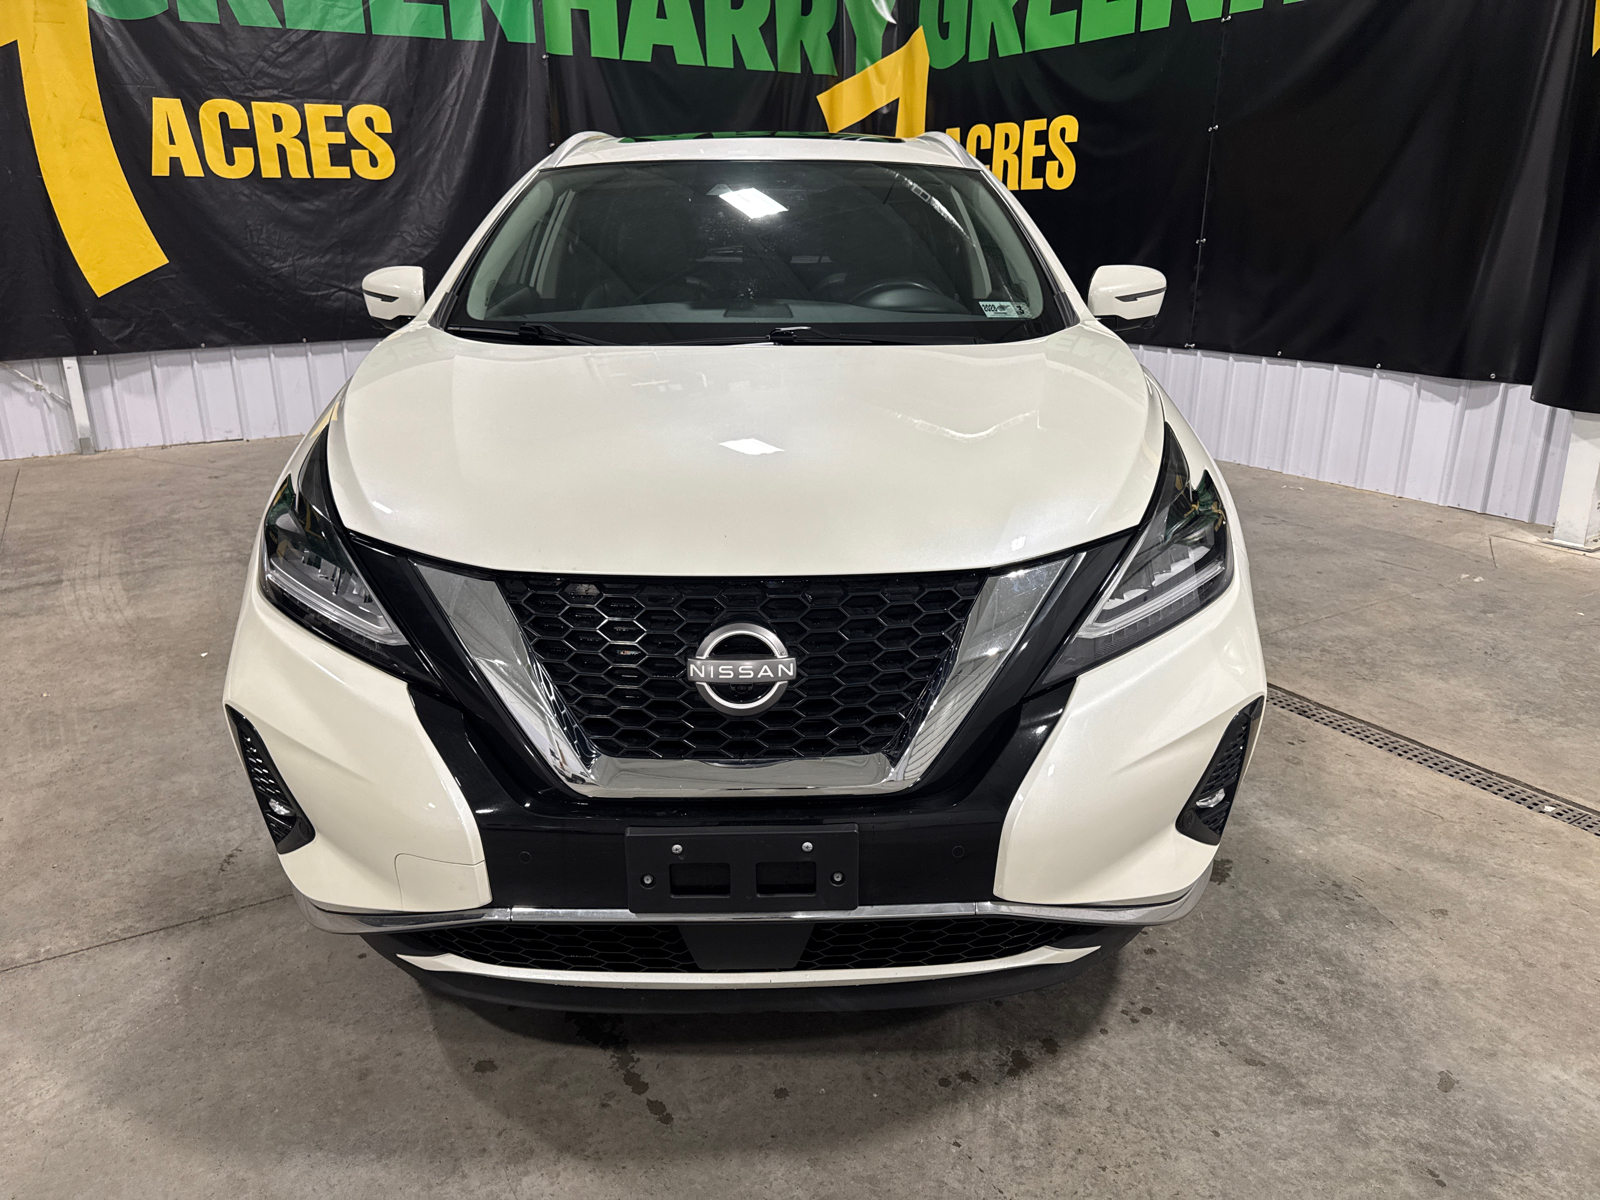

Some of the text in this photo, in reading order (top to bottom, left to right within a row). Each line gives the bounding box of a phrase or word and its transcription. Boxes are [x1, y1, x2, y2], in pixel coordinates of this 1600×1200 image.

[151, 97, 396, 180] ACRES
[945, 114, 1079, 191] CRES
[689, 662, 795, 679] NISSAN
